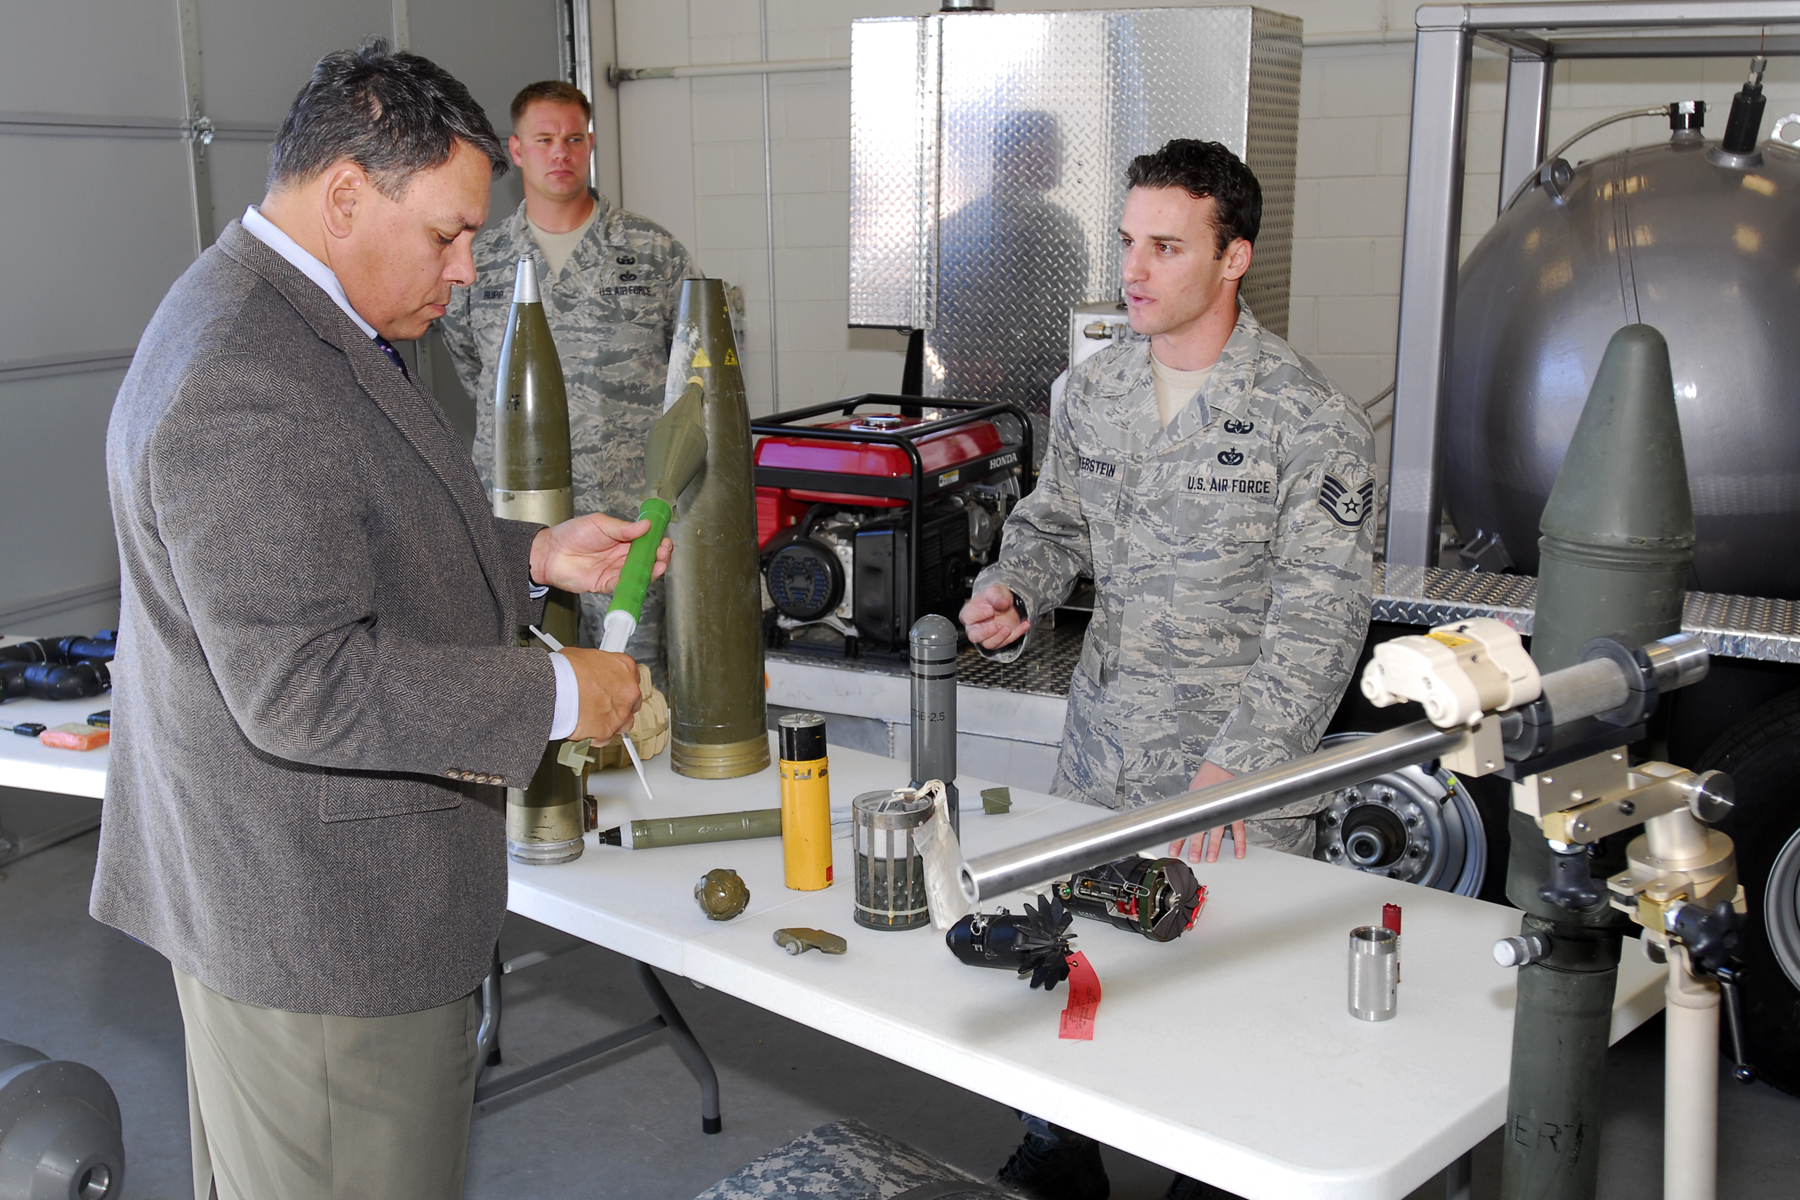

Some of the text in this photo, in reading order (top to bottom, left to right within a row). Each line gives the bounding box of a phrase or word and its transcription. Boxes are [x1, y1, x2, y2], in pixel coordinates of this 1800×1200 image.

[615, 286, 627, 296] AIR
[629, 286, 652, 296] FORCE
[989, 452, 1017, 470] HONDA
[1079, 456, 1116, 477] ERSTEIN
[1187, 476, 1270, 494] U.S. AIR FORCE
